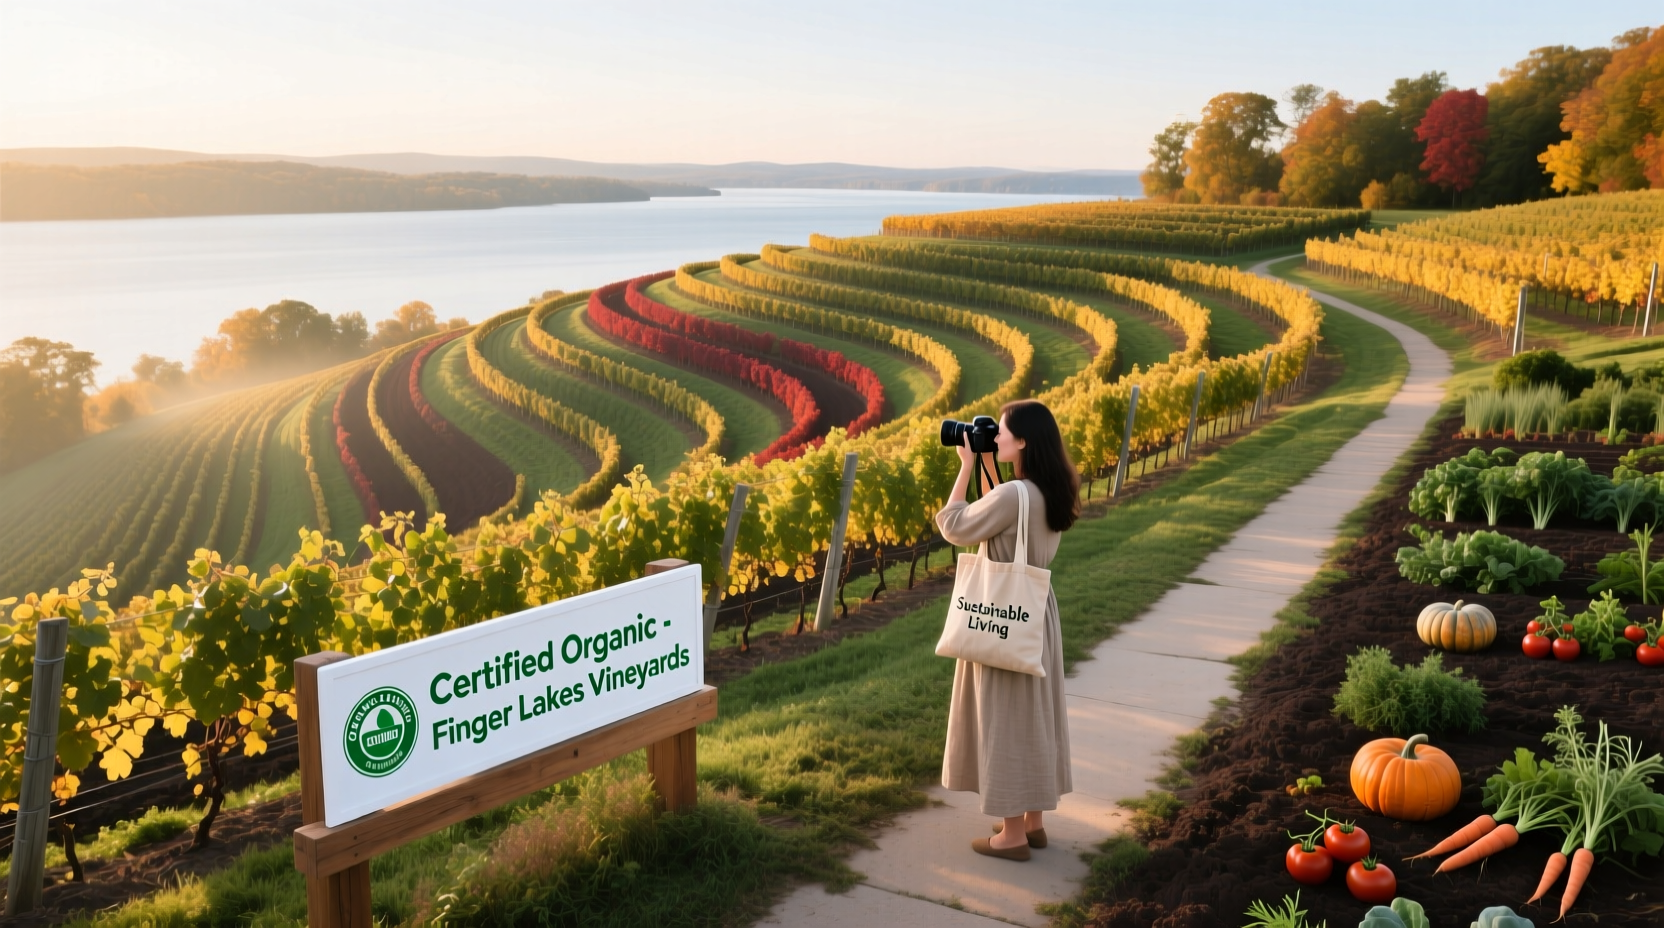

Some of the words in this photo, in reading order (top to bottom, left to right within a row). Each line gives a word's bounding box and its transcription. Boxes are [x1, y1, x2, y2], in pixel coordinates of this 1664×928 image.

[430, 641, 553, 705] Certified
[561, 613, 657, 664] Organic
[968, 616, 1009, 639] Living
[432, 705, 513, 750] Finger
[519, 683, 584, 721] Lakes
[588, 644, 690, 697] Vineyards
